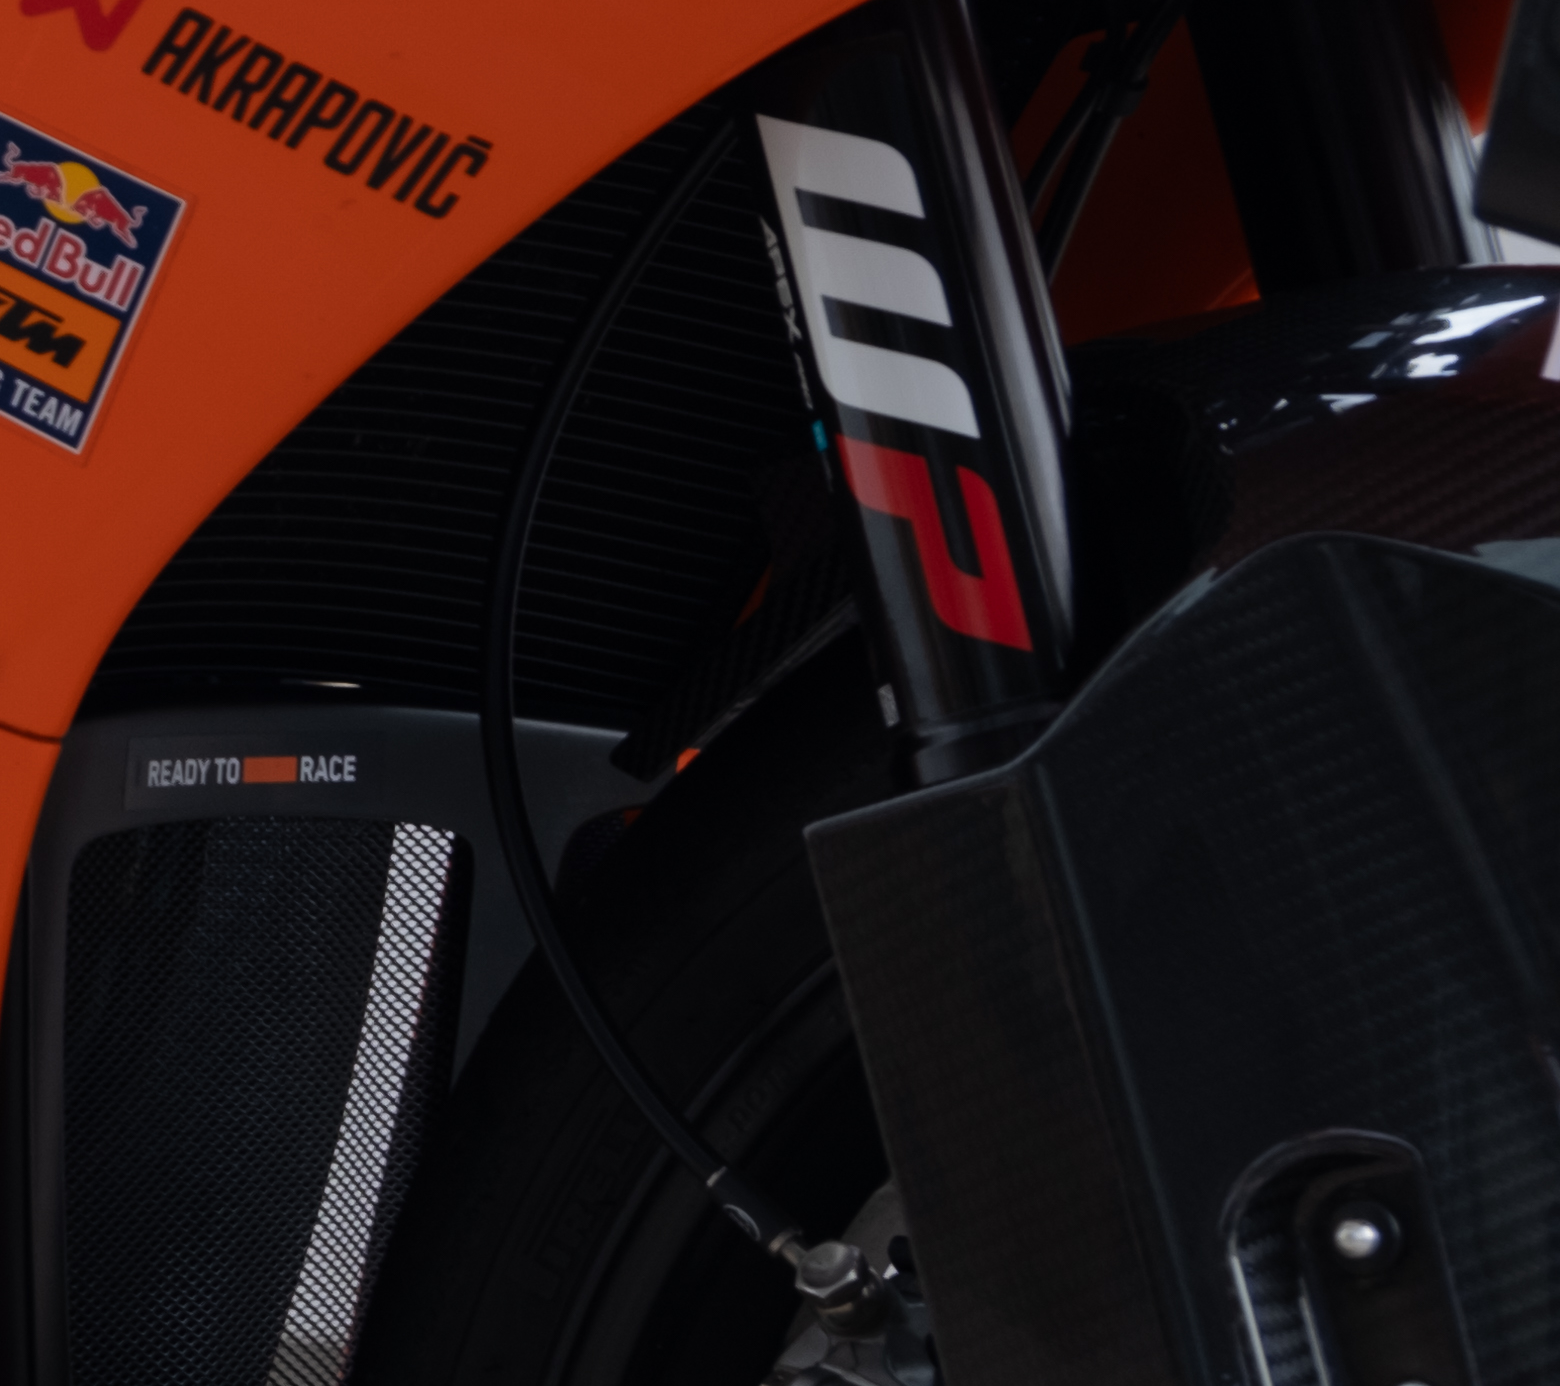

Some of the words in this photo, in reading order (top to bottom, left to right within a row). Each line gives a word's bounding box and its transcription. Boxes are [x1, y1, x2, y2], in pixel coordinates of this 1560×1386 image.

[141, 6, 493, 219] AKRAPOVIČ
[10, 377, 85, 438] TEAM
[147, 757, 210, 788] READY
[213, 757, 241, 786] TO
[299, 754, 357, 784] RACE
